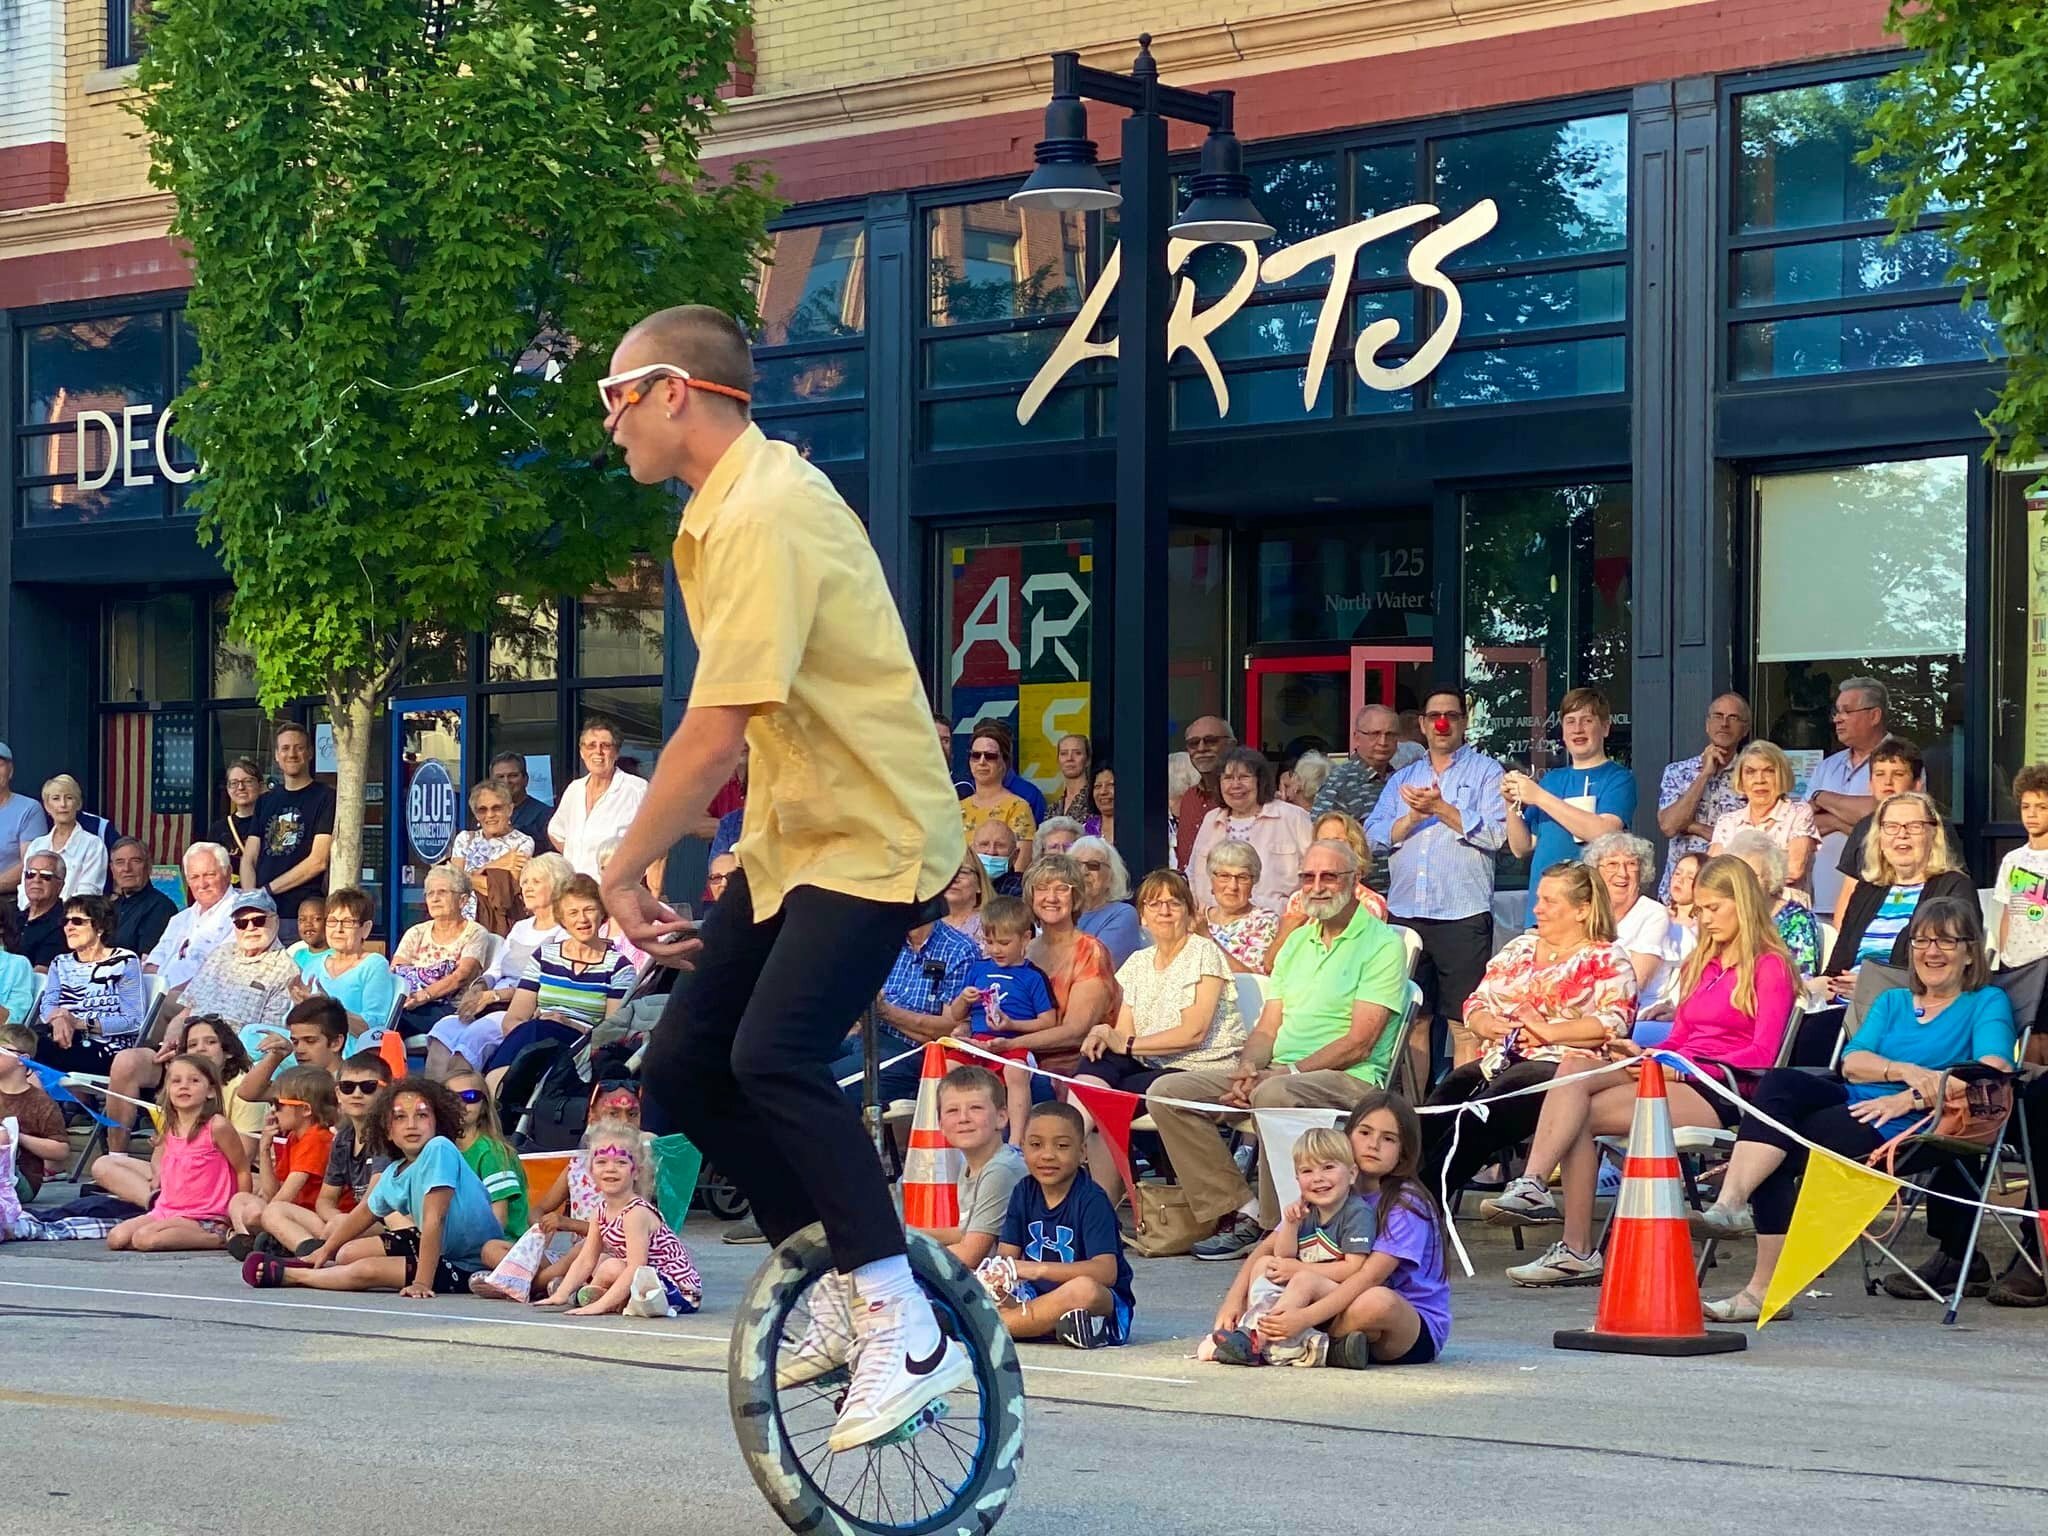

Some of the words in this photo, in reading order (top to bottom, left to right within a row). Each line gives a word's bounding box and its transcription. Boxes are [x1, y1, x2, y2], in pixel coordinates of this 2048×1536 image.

[77, 404, 208, 491] DEC
[1379, 548, 1425, 578] 125
[1325, 592, 1372, 612] North
[1376, 591, 1425, 609] Water
[952, 572, 1091, 686] AR
[1516, 715, 1541, 728] AREA
[1608, 713, 1631, 725] NCIL
[411, 783, 453, 822] BLUE
[412, 823, 451, 838] CONNECTION
